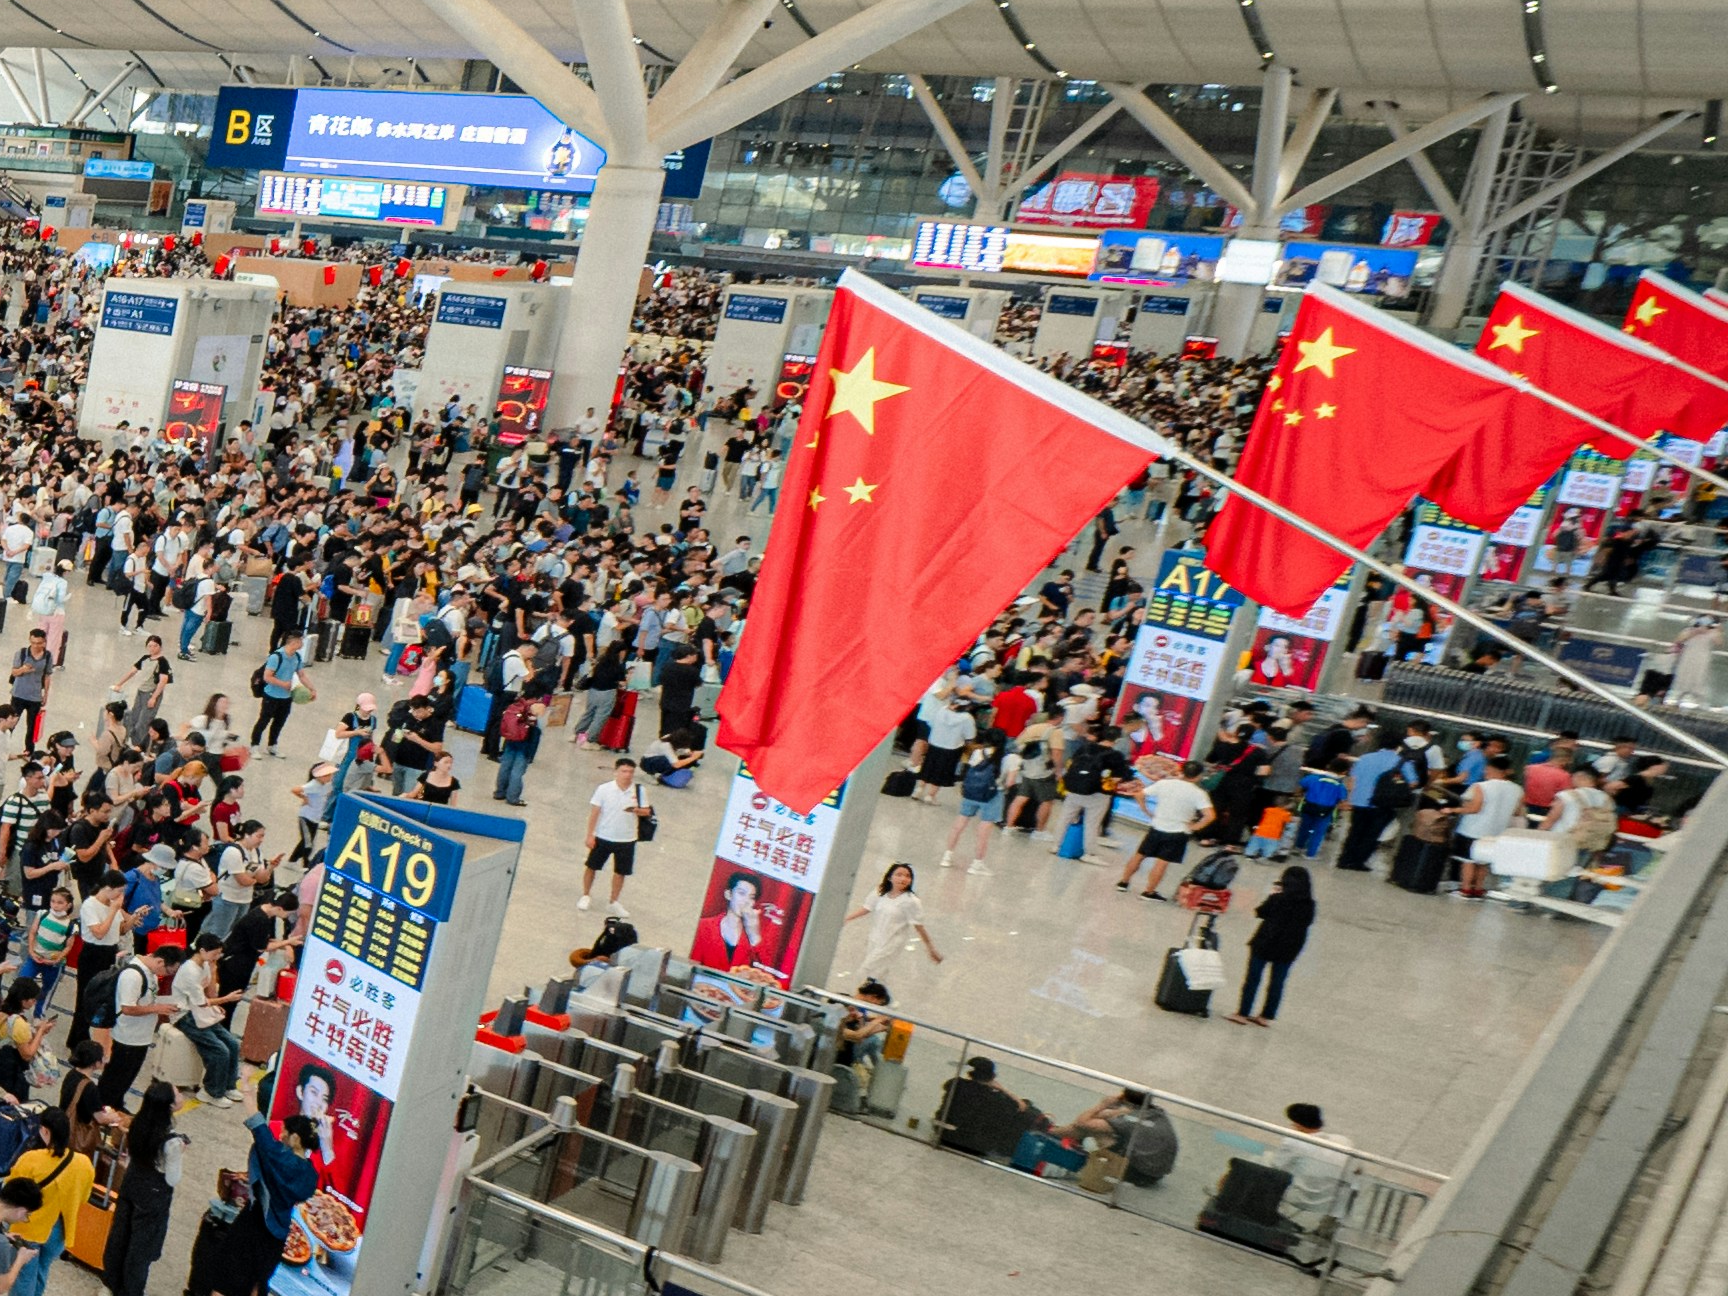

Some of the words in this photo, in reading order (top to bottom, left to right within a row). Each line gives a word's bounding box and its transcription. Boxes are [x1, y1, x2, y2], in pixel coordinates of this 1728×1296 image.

[307, 114, 372, 137] 青花郎
[390, 825, 420, 848] Check
[334, 825, 436, 907] A19
[350, 976, 395, 1010] 必胜客
[311, 984, 394, 1051] 牛气必胜
